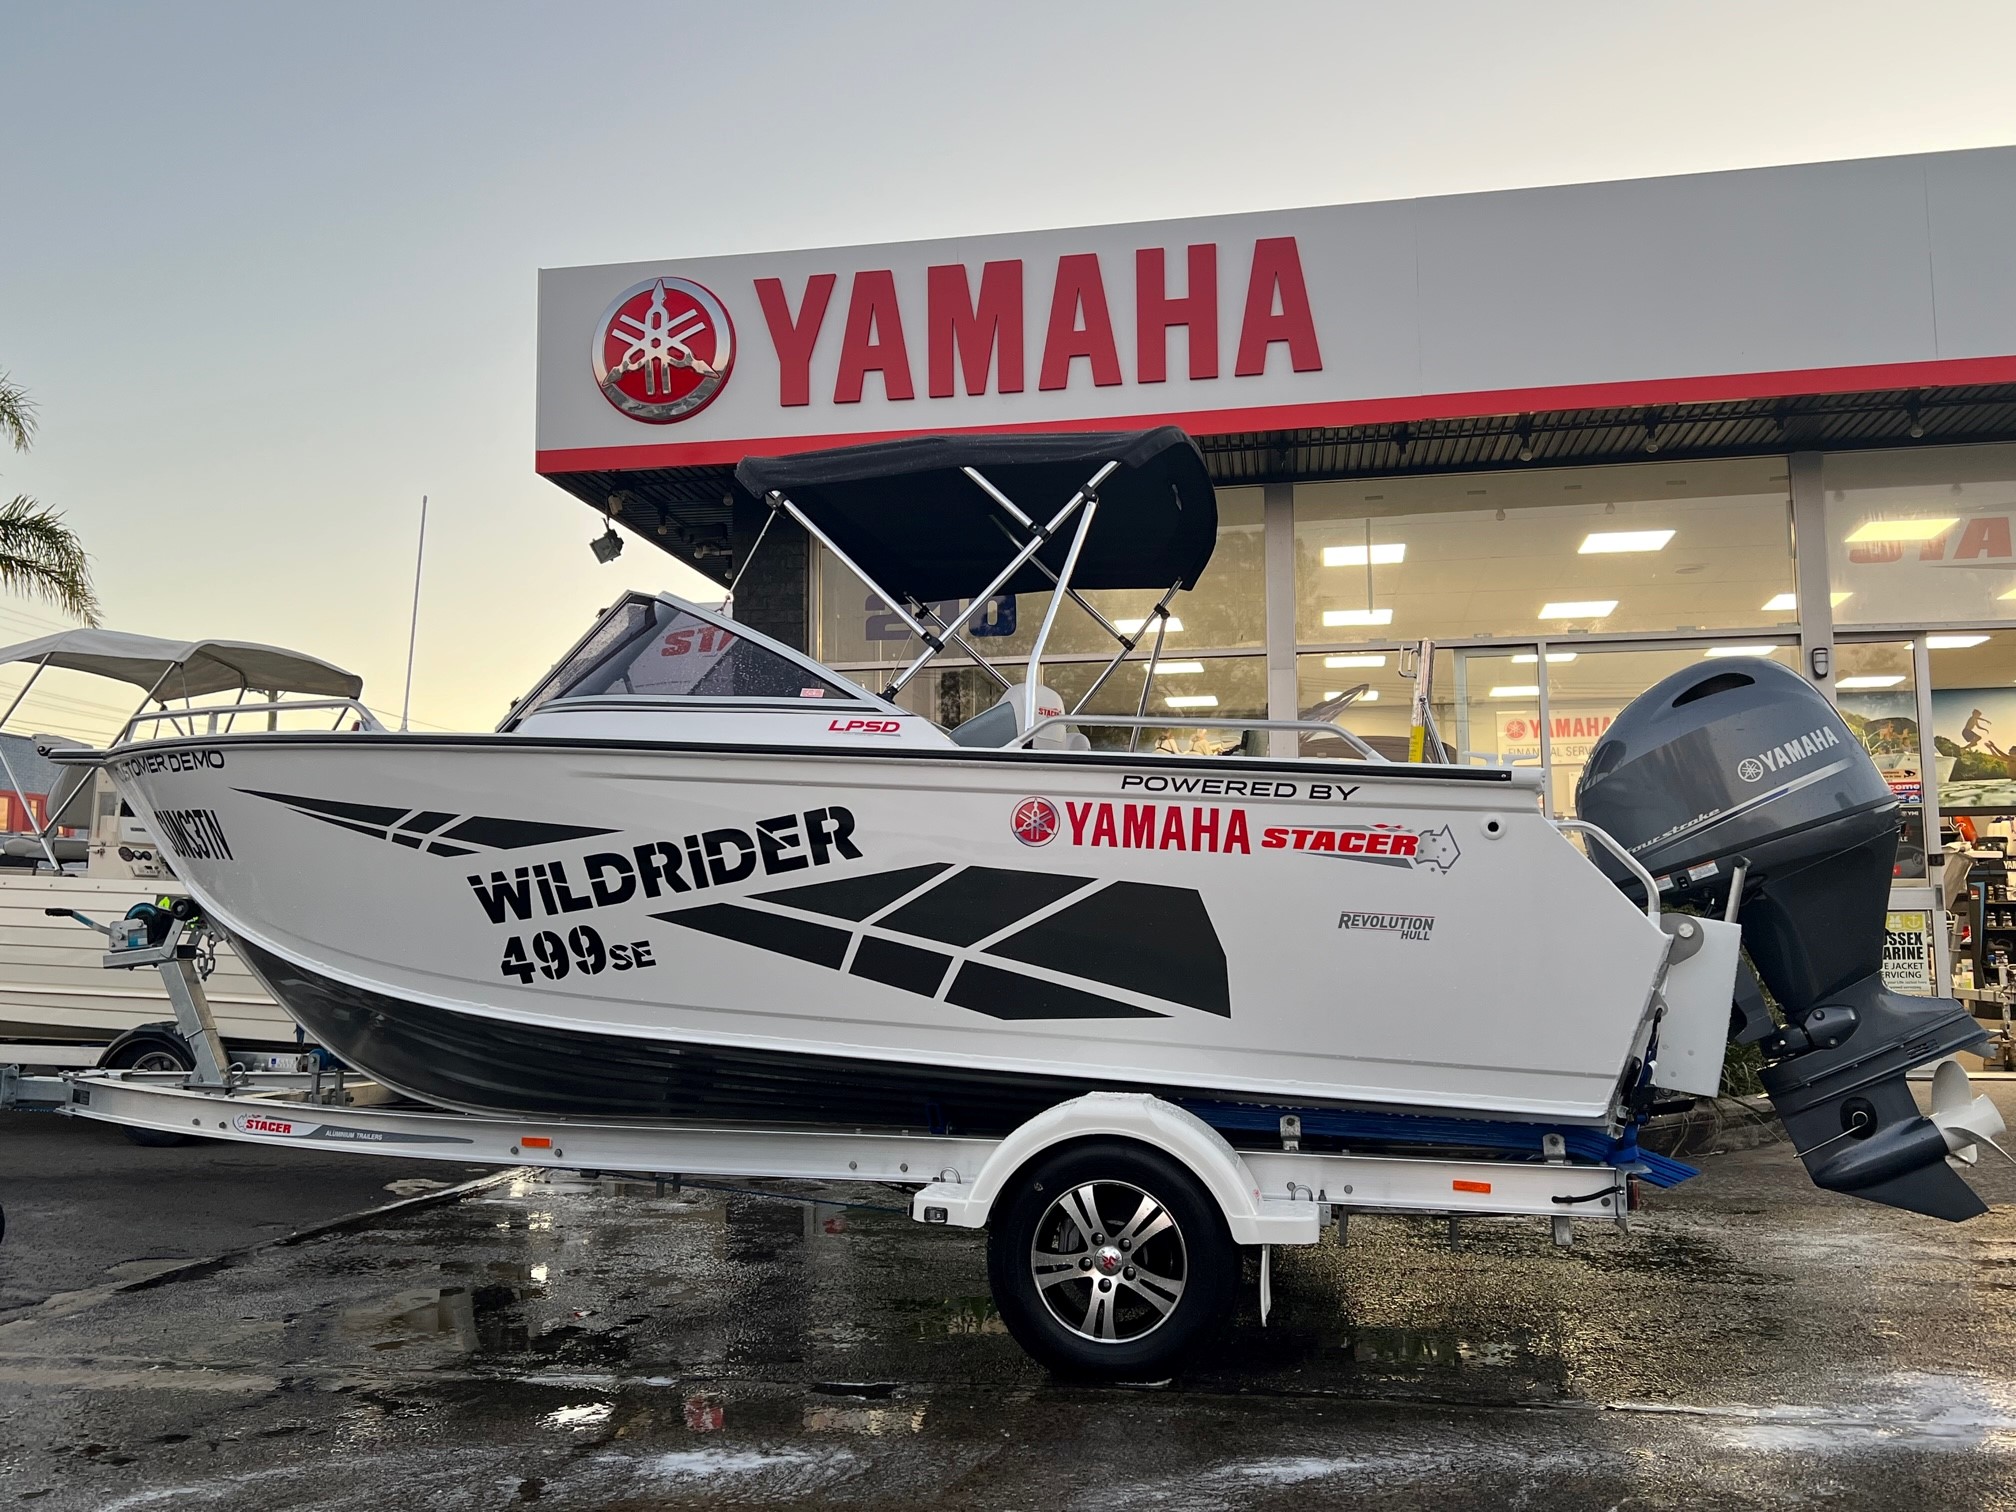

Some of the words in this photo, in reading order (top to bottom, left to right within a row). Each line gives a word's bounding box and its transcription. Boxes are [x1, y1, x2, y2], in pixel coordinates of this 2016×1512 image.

[753, 236, 1323, 406] YAMAHA
[828, 719, 901, 733] LPSD
[1759, 725, 1840, 773] YAMAHA
[168, 750, 225, 773] DEMO
[1120, 774, 1297, 798] POWERED
[1308, 784, 1361, 801] BY
[1065, 801, 1251, 855] YAMAHA
[1260, 827, 1420, 857] STACER
[1338, 911, 1434, 931] REVOLUTION
[1400, 930, 1430, 941] HULL
[1883, 946, 1924, 960] ARINE
[1880, 970, 1922, 979] ERVICING
[1891, 962, 1924, 970] JACKET
[246, 1119, 292, 1134] STACER
[356, 1132, 383, 1141] TRAILERS
